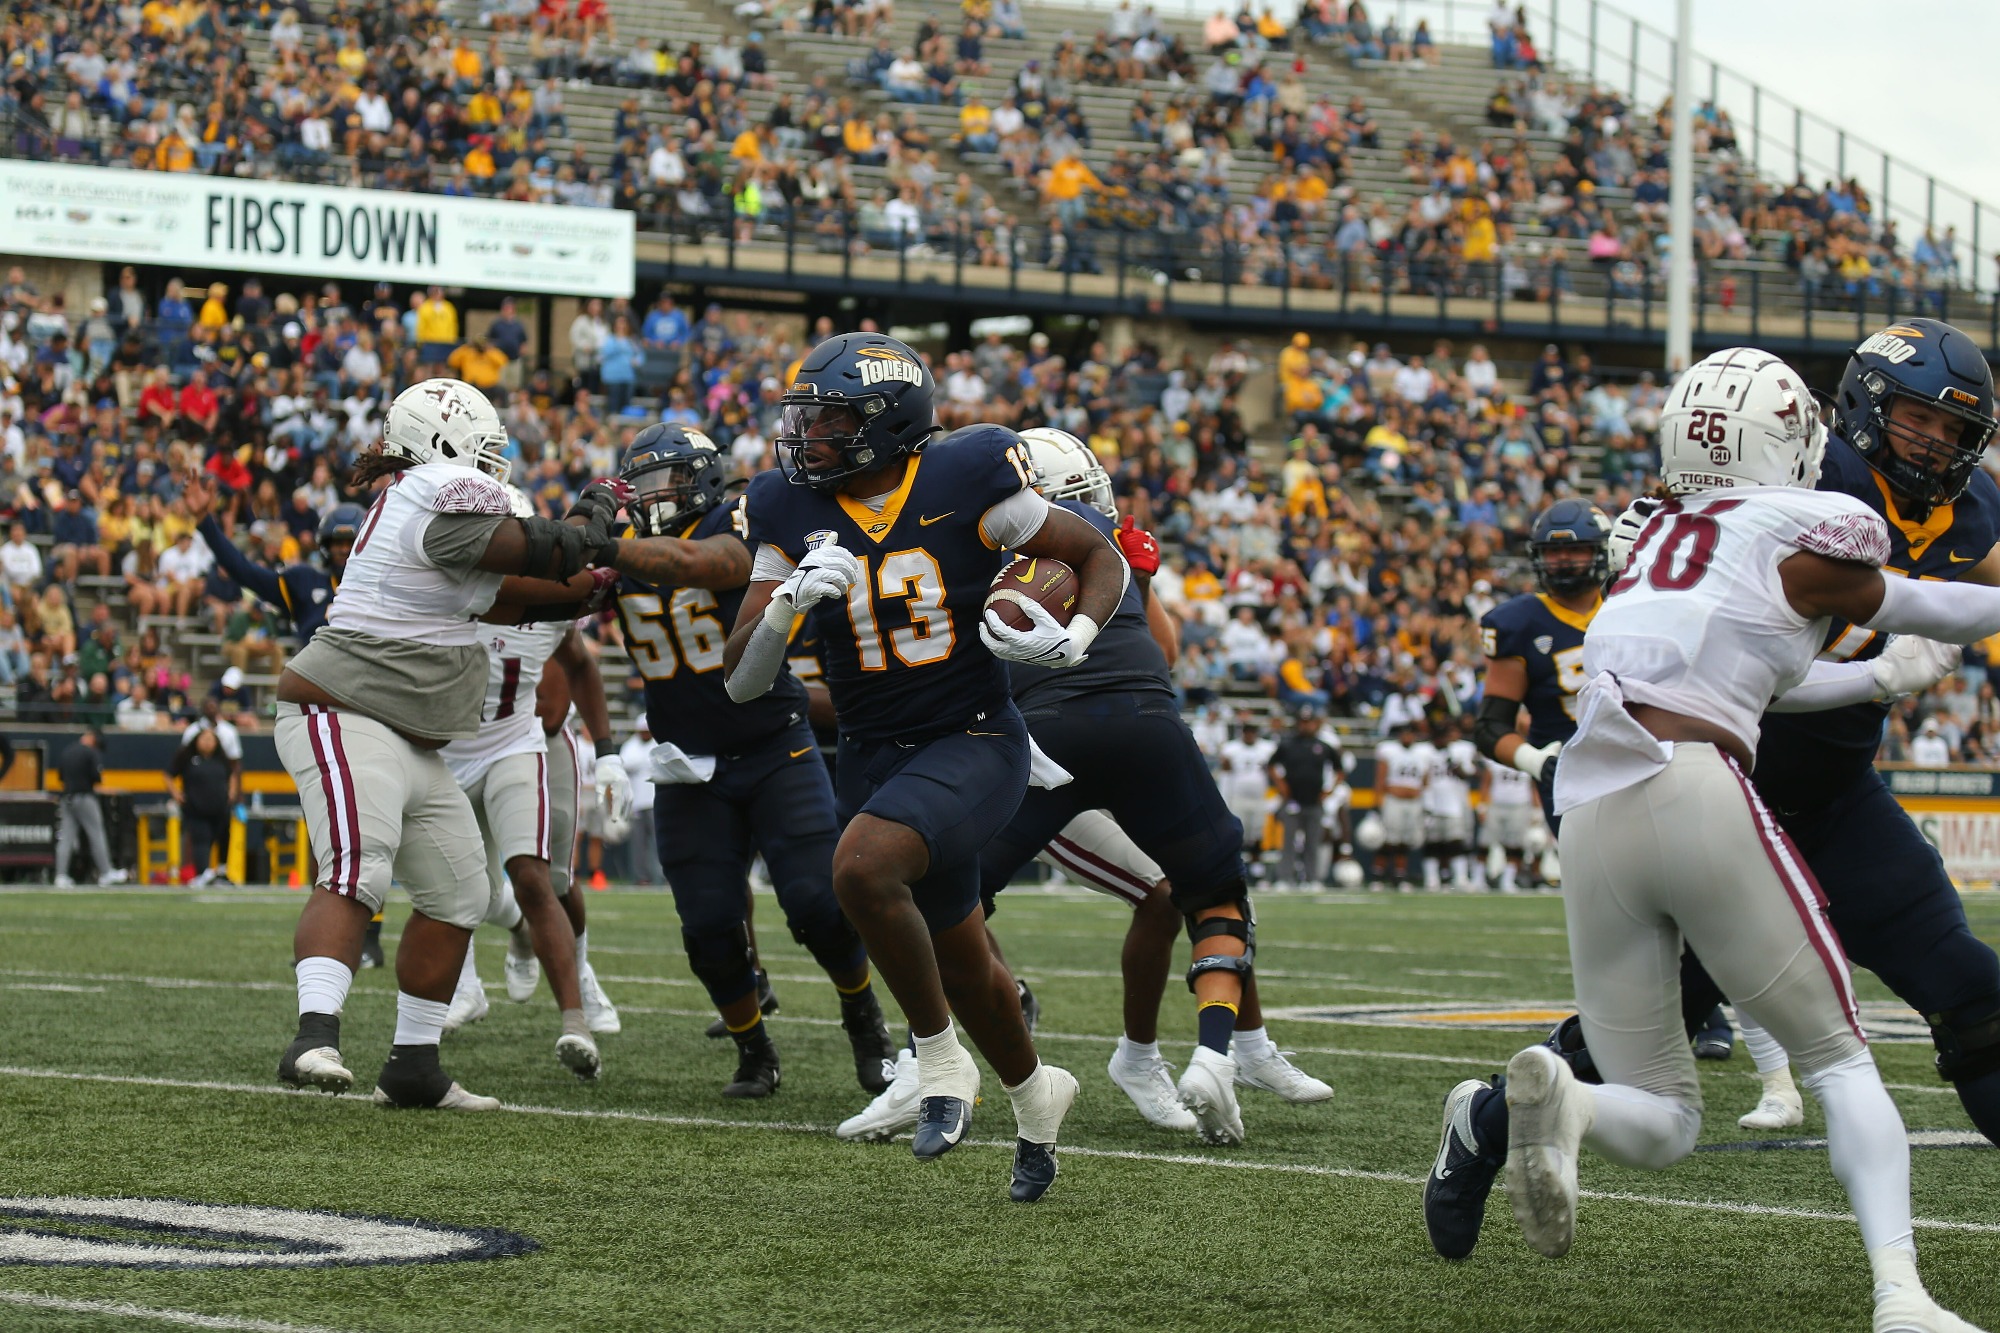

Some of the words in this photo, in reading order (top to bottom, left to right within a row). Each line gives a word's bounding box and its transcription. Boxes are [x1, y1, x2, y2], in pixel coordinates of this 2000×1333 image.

[206, 195, 305, 255] FIRST
[323, 204, 437, 265] DOWN
[1856, 333, 1917, 364] OLEDO
[855, 358, 923, 388] TOLEDO
[1687, 409, 1727, 444] 26
[1005, 442, 1038, 493] 13
[1712, 449, 1730, 463] ED
[1679, 473, 1734, 488] TIGERS
[846, 547, 956, 671] 13
[617, 587, 728, 681] 56
